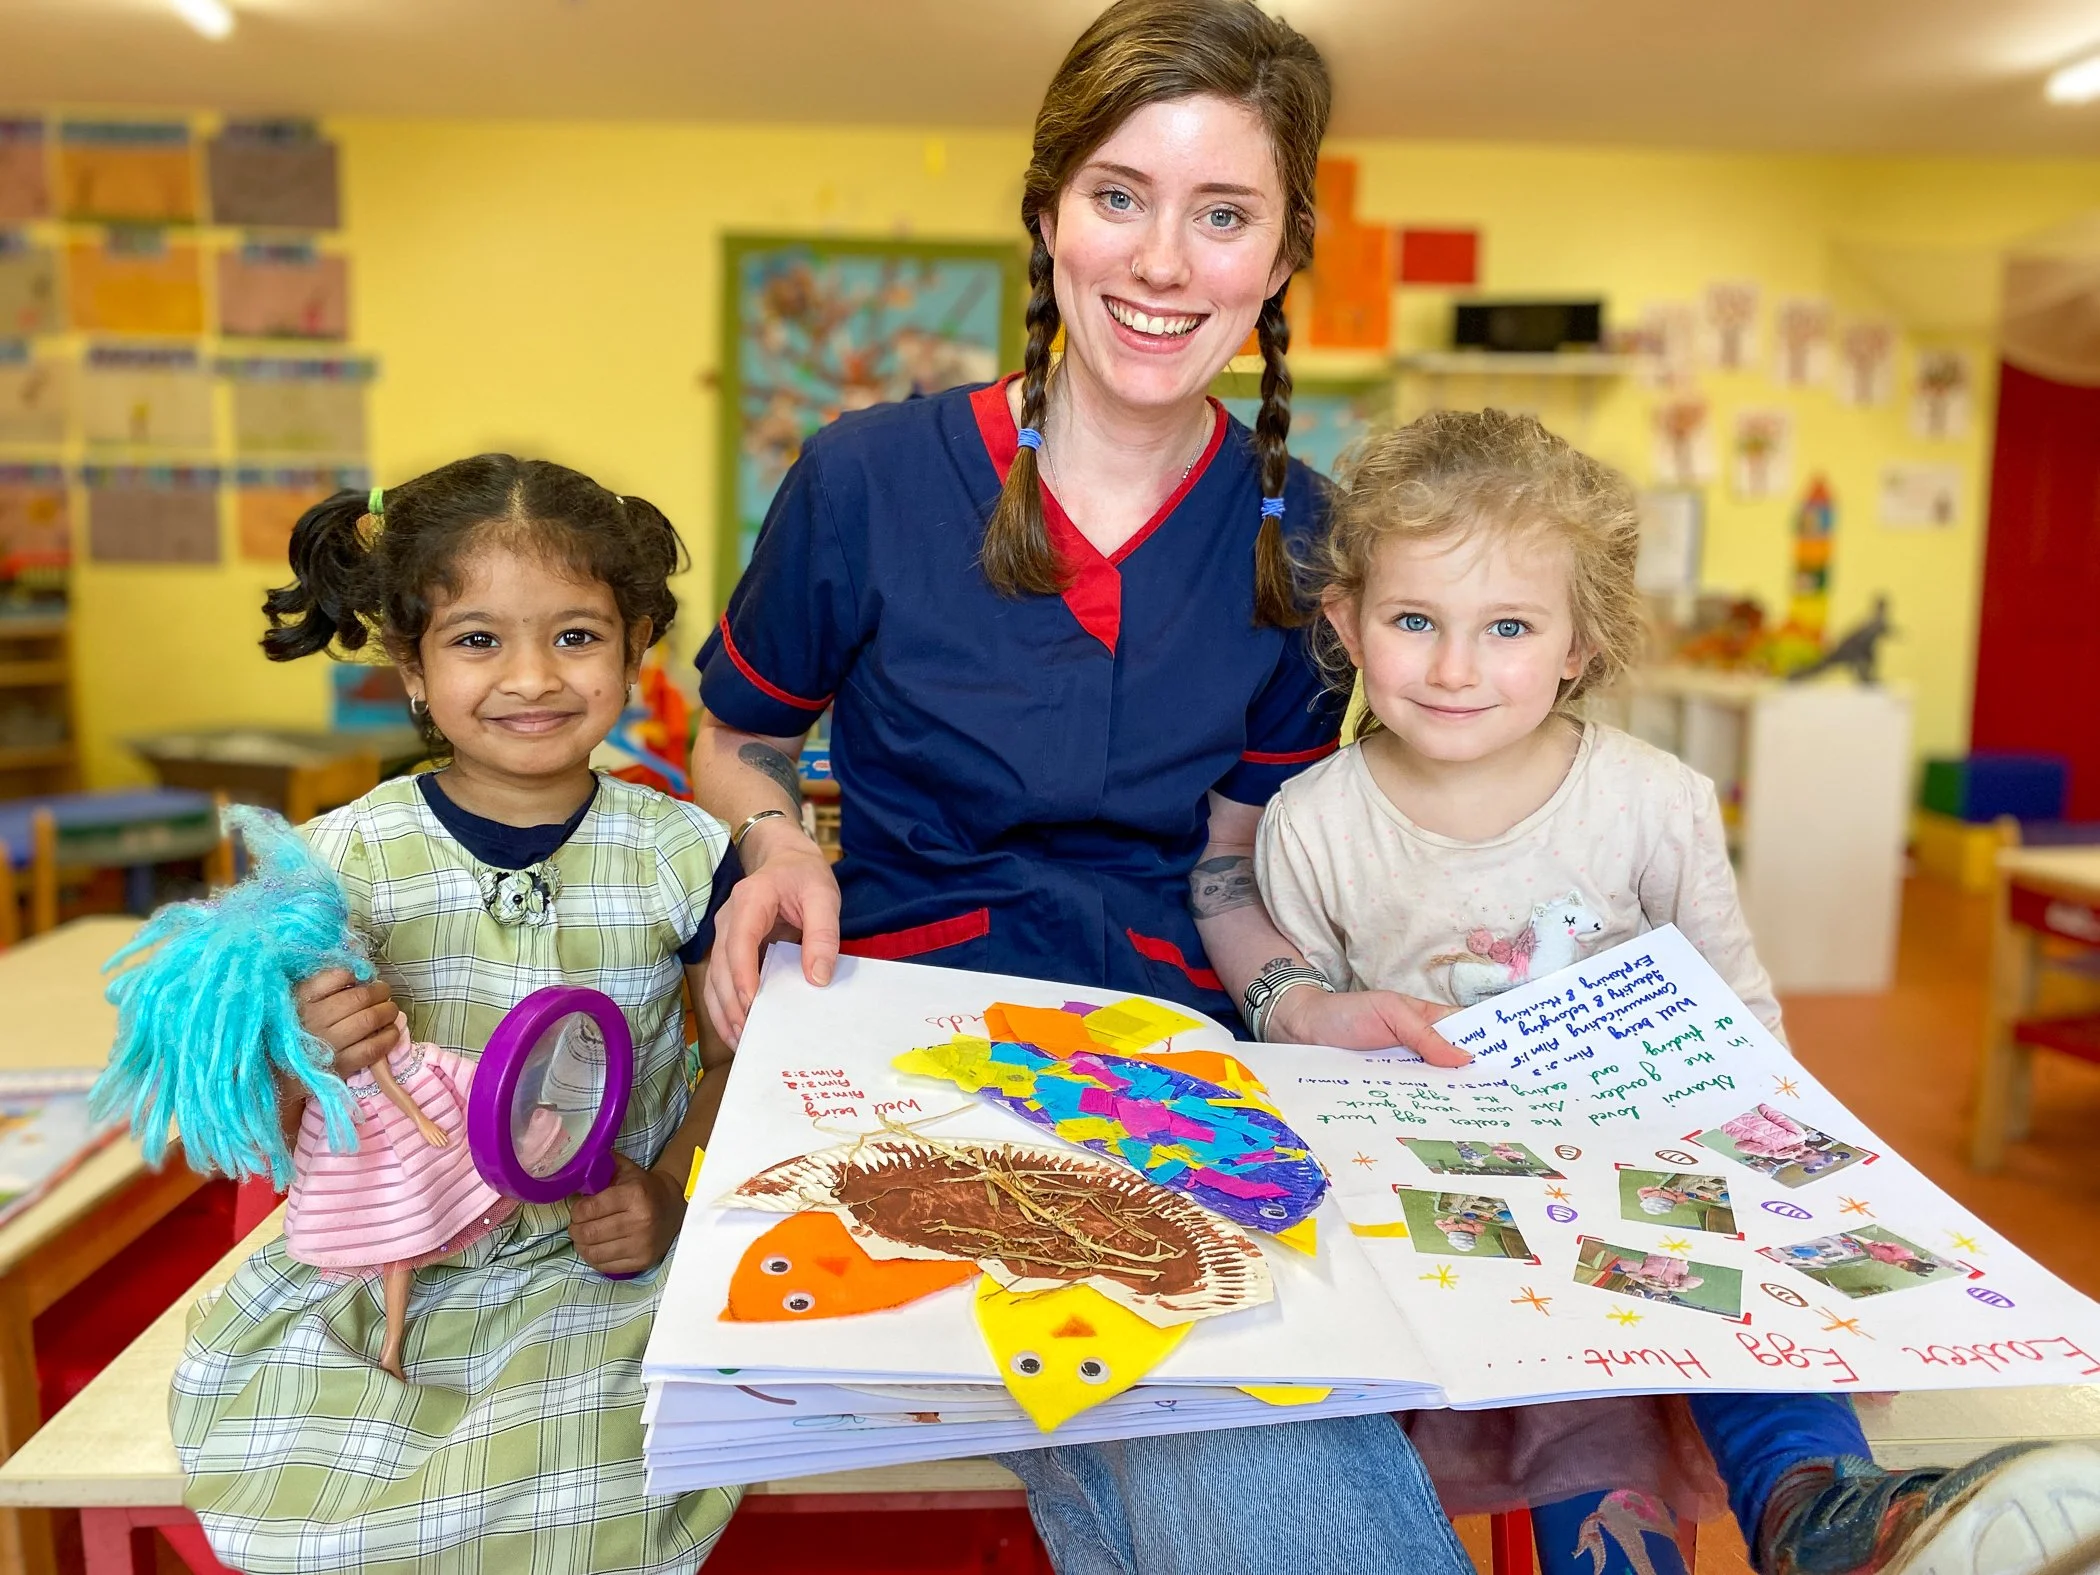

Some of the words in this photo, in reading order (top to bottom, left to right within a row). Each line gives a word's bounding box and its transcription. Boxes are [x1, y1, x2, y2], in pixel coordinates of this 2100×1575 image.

[1578, 954, 1655, 991] Exploring
[1606, 970, 1665, 1001] Identity
[1565, 988, 1576, 1002] &
[1592, 994, 1605, 1008] &
[1494, 995, 1562, 1026] thinking
[1565, 981, 1678, 1039] Communicating
[1655, 997, 1698, 1021] Well
[1517, 1003, 1590, 1038] belonging
[1606, 1017, 1655, 1041] being
[1713, 1016, 1734, 1031] at
[1458, 1026, 1487, 1045] Aim
[1641, 1024, 1706, 1058] finding
[1477, 1039, 1508, 1057] Aim
[1529, 1037, 1561, 1056] Aim
[1563, 1045, 1595, 1063] Aim
[1683, 1051, 1716, 1067] the
[811, 1069, 845, 1078] Aim
[1587, 1065, 1620, 1086] and
[818, 1079, 850, 1088] Aim
[1510, 1082, 1568, 1099] eating
[832, 1090, 865, 1099] Aim
[1471, 1095, 1500, 1104] the
[804, 1102, 858, 1118] being
[872, 1098, 921, 1115] Well
[1336, 1099, 1397, 1109] quick
[1411, 1101, 1461, 1113] very
[1476, 1105, 1513, 1113] was
[1528, 1100, 1564, 1112] She
[1316, 1114, 1377, 1125] hunt
[1389, 1109, 1427, 1124] egg
[1448, 1119, 1511, 1129] easter
[1531, 1118, 1562, 1127] the
[1587, 1106, 1640, 1127] loved
[1736, 1333, 1860, 1384] Egg
[1902, 1337, 2100, 1376] Easter
